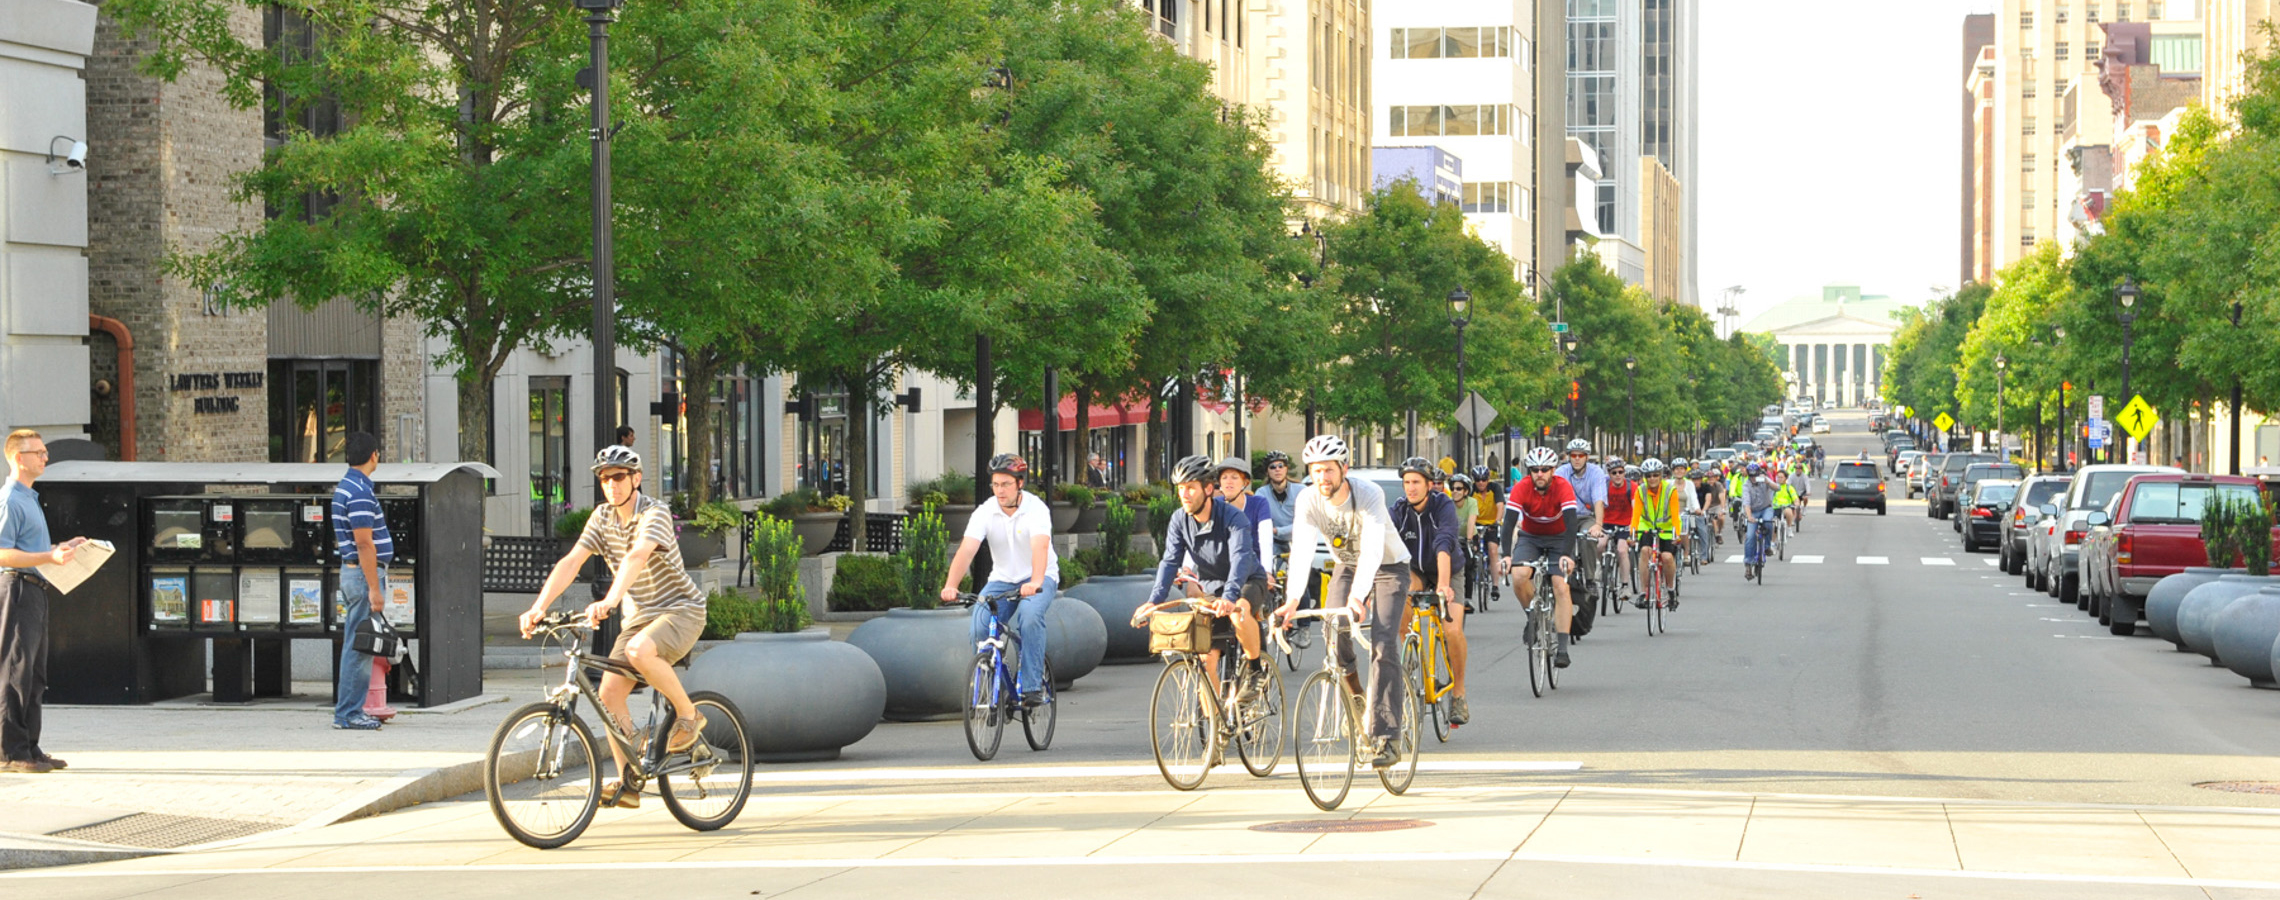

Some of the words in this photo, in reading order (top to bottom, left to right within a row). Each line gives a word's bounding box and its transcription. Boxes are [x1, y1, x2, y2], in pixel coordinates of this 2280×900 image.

[170, 373, 219, 390] LAWYERS
[223, 372, 263, 388] WEEKLY
[194, 396, 239, 413] BUILDING
